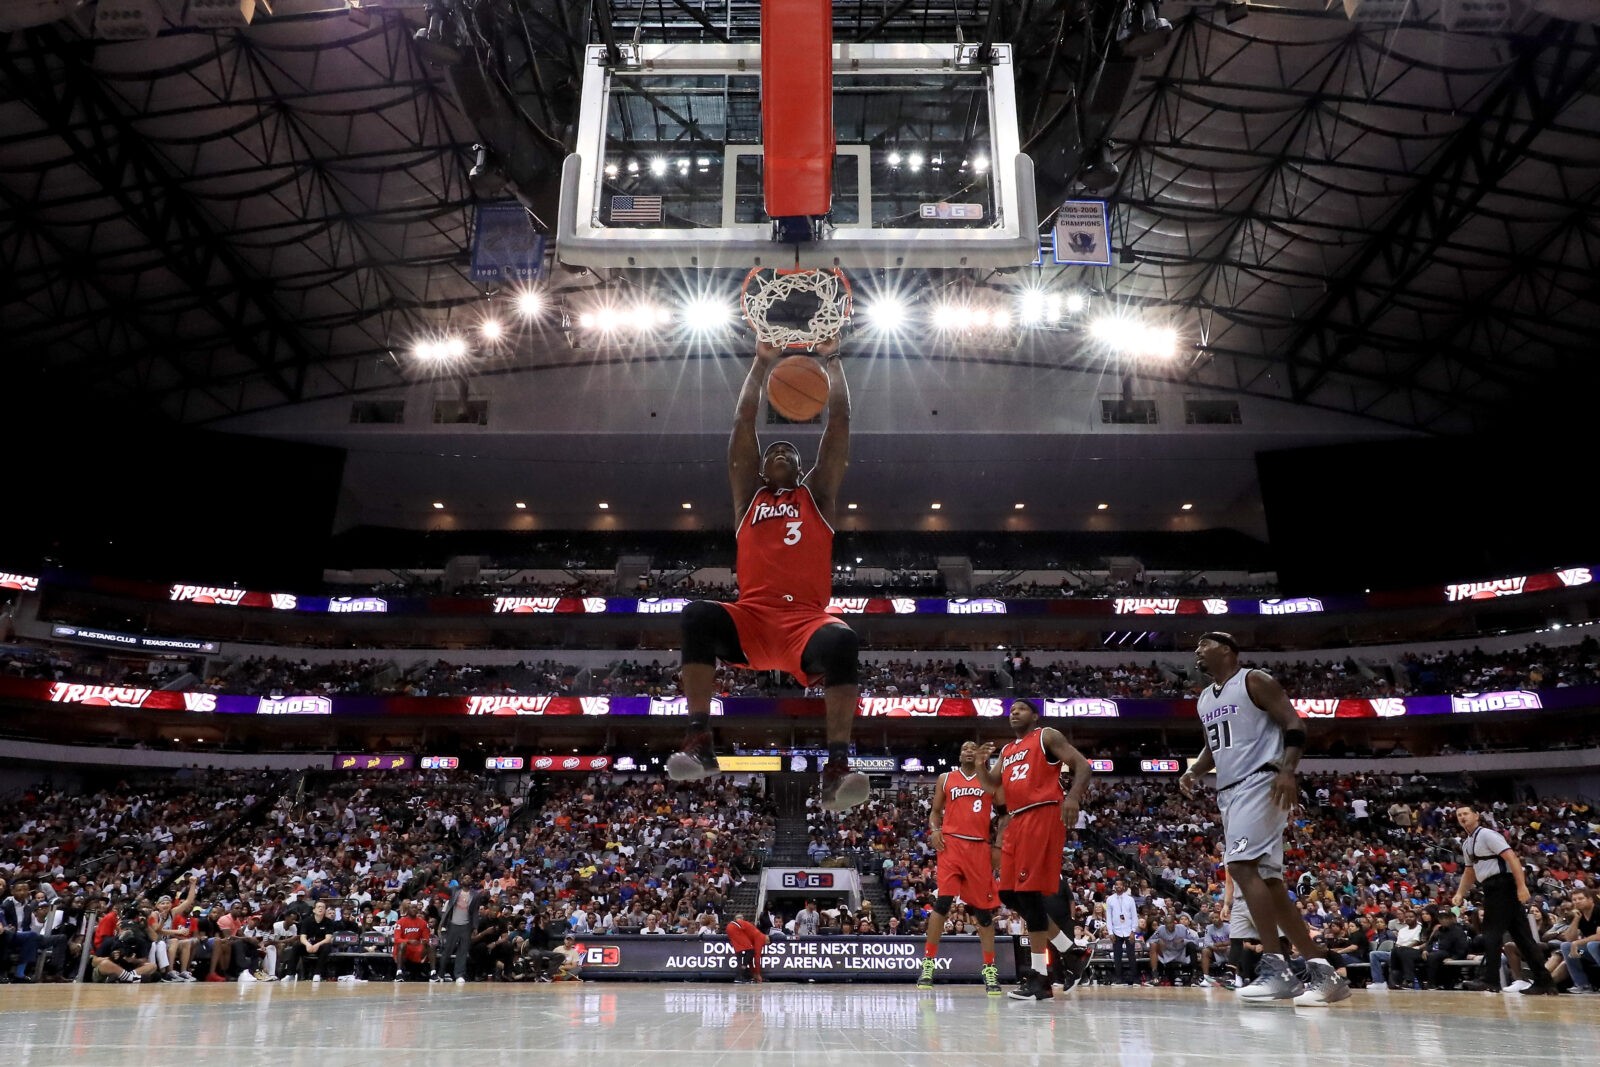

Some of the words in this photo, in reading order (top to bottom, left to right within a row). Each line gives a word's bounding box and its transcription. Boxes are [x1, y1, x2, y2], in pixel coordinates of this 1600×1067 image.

[784, 521, 803, 546] 3
[1557, 568, 1593, 586] VS
[271, 593, 297, 609] VS
[331, 600, 385, 612] GHOST
[583, 598, 606, 613] VS
[828, 598, 868, 613] LOGY
[893, 599, 916, 613] VS
[949, 601, 1004, 613] GHOST
[1203, 599, 1228, 614] VS
[1262, 601, 1319, 613] GHOST
[78, 631, 116, 641] MUSTANG
[142, 639, 200, 649] TEXASFORD.COM
[184, 692, 216, 712] VS
[259, 697, 328, 714] GHOST
[580, 697, 609, 715] VS
[858, 698, 943, 716] TRILOGY
[972, 698, 1003, 716] VS
[1046, 701, 1114, 716] GHOST
[1370, 698, 1406, 717] VS
[1454, 694, 1535, 713] GHOST
[1202, 704, 1239, 724] GHOST
[1207, 720, 1232, 753] 31
[852, 759, 894, 767] HENDORF'S
[951, 786, 984, 800] TRILOGY
[973, 800, 982, 812] 8
[783, 871, 833, 888] BIG3
[761, 943, 785, 954] ISS
[789, 943, 817, 954] THE
[821, 943, 860, 955] NEXT
[862, 943, 915, 955] ROUND
[666, 956, 725, 968] AUGUST
[728, 957, 738, 968] 6
[742, 957, 780, 968] PP
[783, 957, 832, 968] ARENA
[845, 957, 925, 969] LEXINGTON
[933, 957, 952, 969] KY
